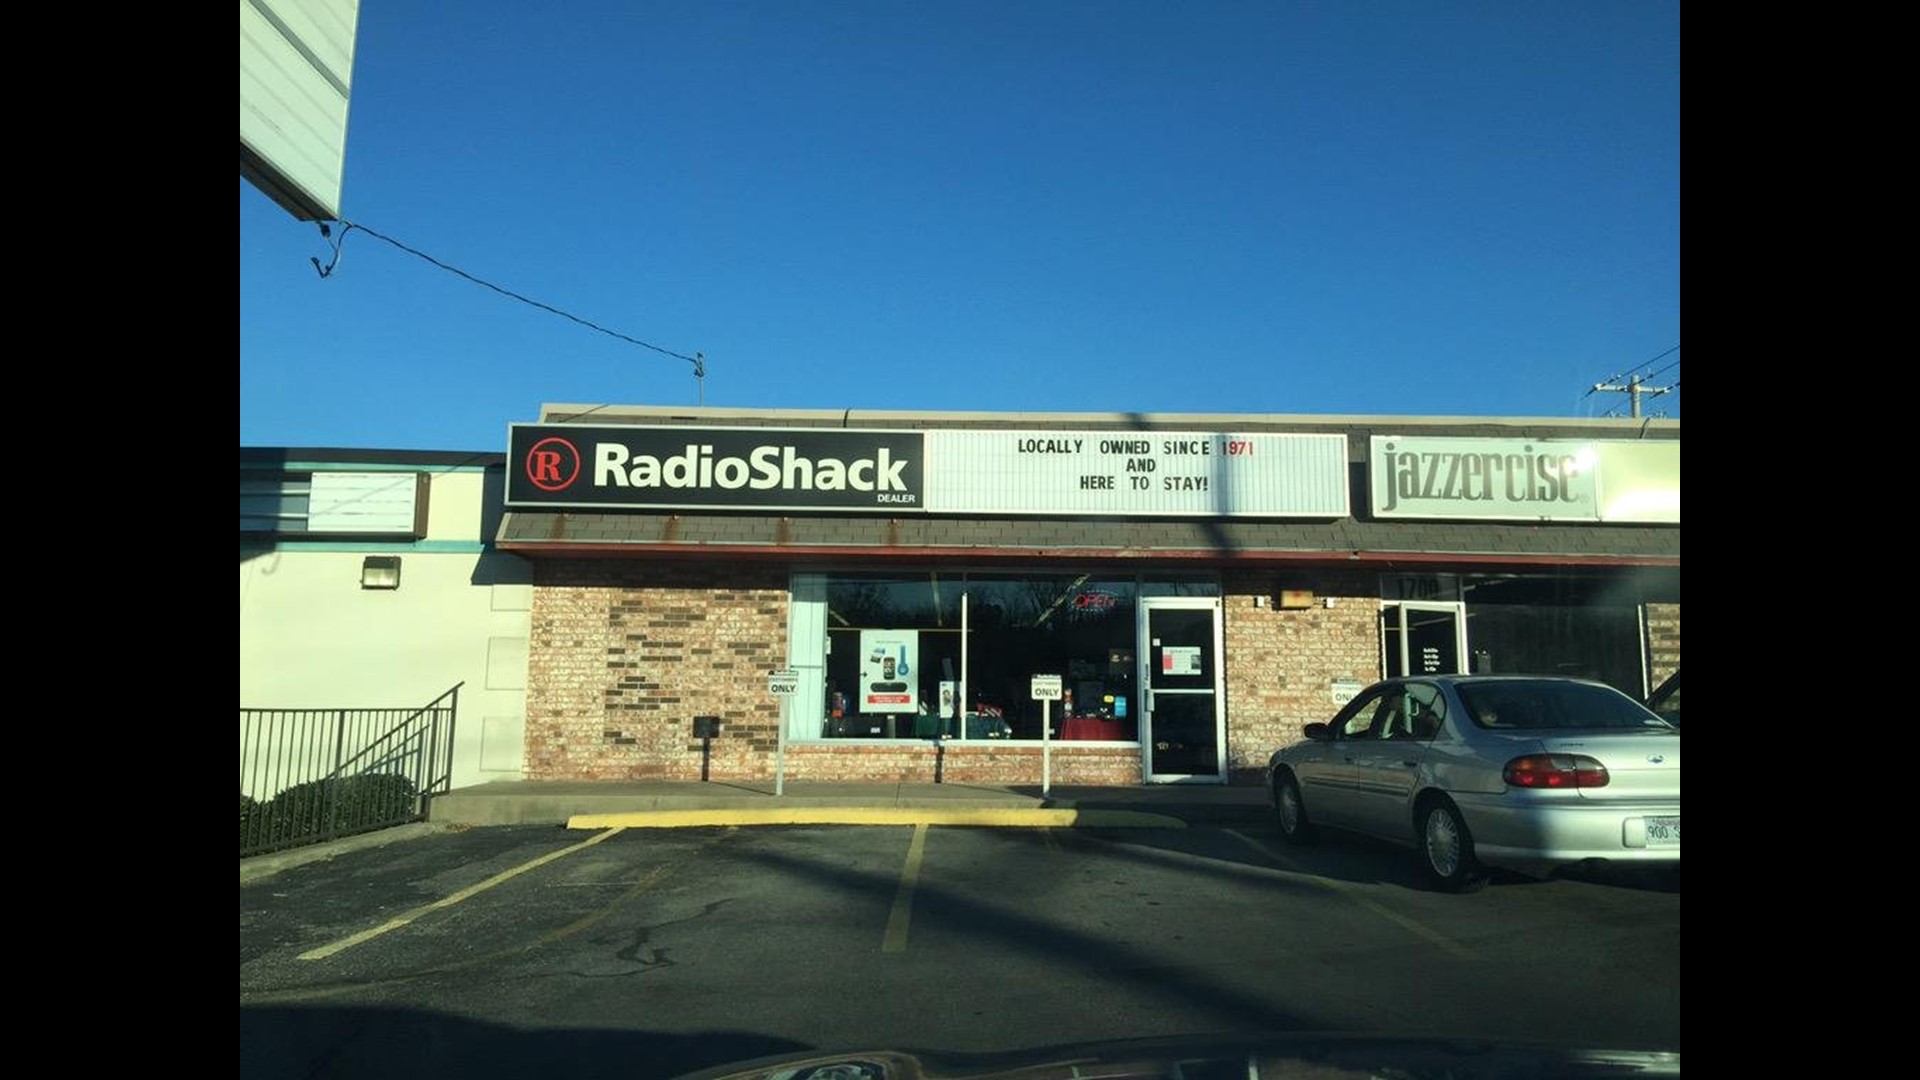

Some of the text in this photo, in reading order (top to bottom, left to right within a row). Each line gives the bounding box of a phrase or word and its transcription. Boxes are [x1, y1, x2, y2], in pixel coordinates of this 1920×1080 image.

[1018, 440, 1254, 456] LOCALLY OWNED SINCE 1971
[594, 443, 909, 493] RadioShack
[1126, 458, 1156, 473] AND
[1080, 475, 1208, 492] HERE TO STAY!
[1382, 443, 1578, 512] jazzercise
[877, 493, 915, 503] DEALER
[1072, 593, 1116, 608] OPEN
[771, 684, 796, 693] ONLY
[1035, 687, 1059, 697] ONLY
